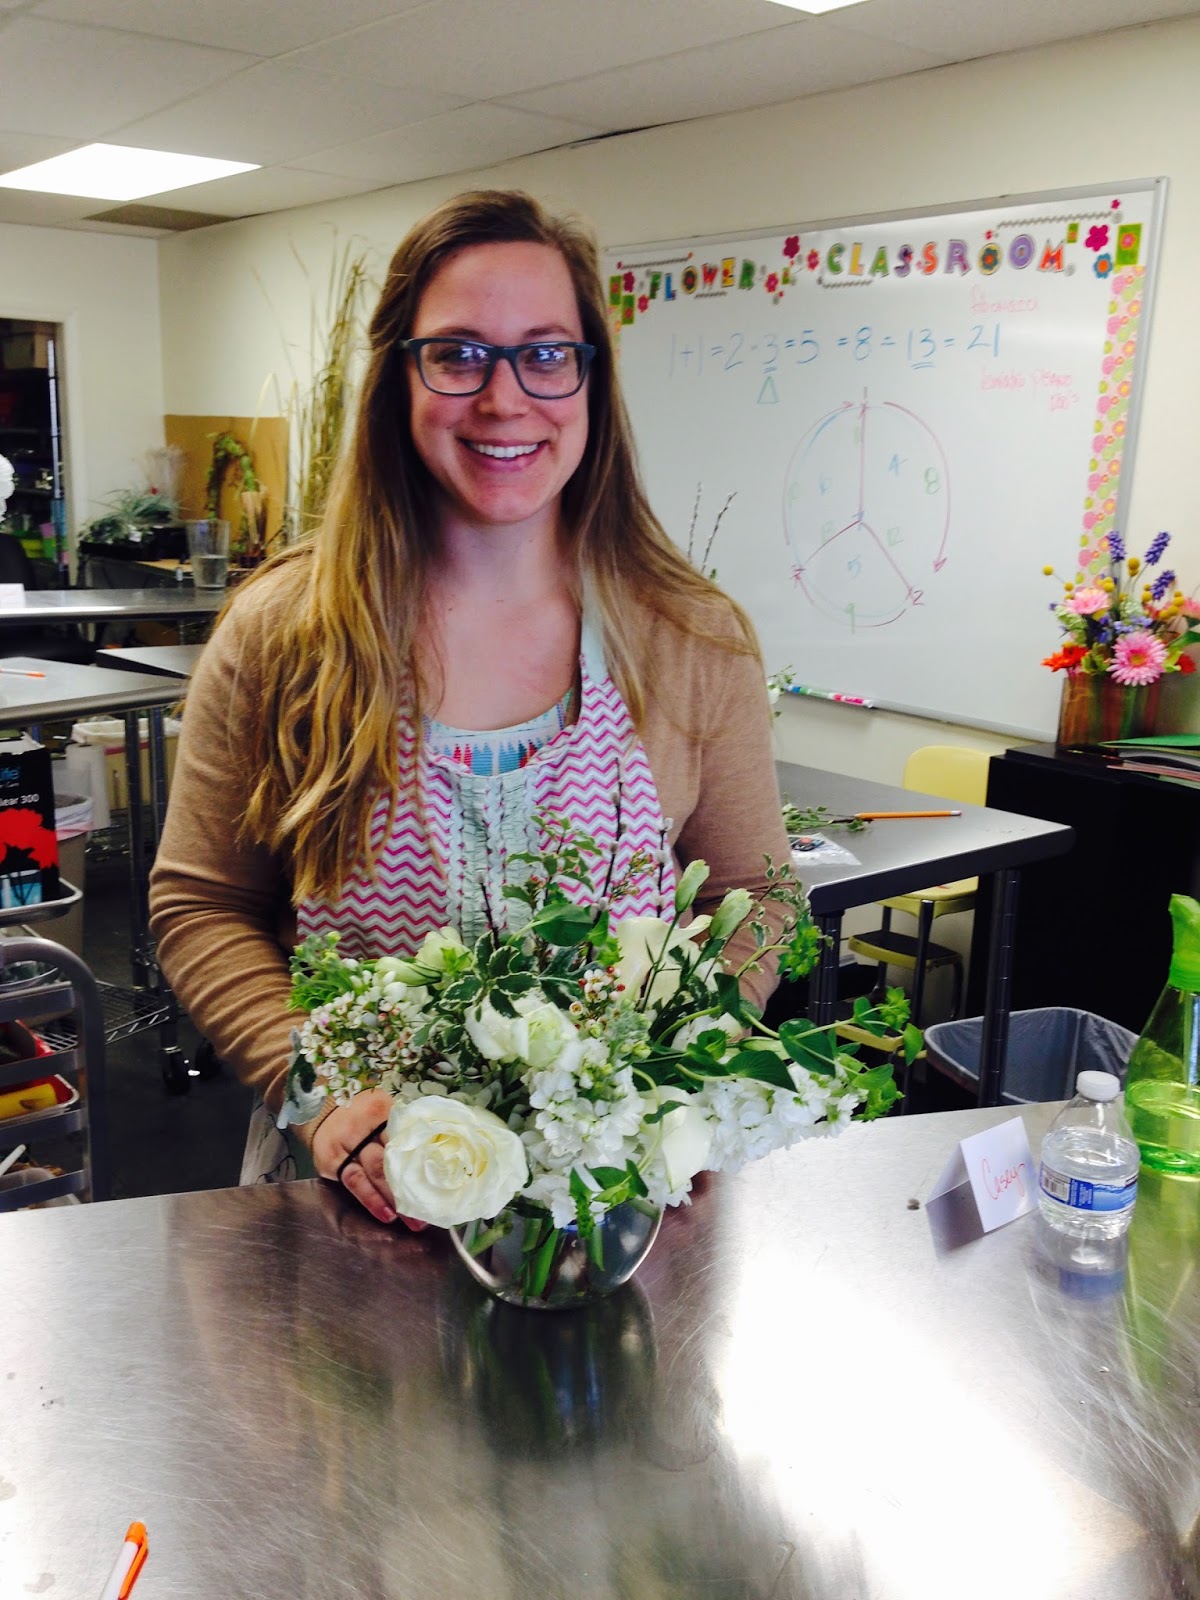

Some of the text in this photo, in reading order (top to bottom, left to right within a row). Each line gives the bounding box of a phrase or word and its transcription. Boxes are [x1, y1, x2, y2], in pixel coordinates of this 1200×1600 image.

[649, 234, 1066, 301] FLOWER CLASSROOM
[966, 322, 1001, 358] 21
[923, 466, 942, 496] 8
[20, 794, 40, 804] 300
[981, 1158, 1026, 1201] Casey
